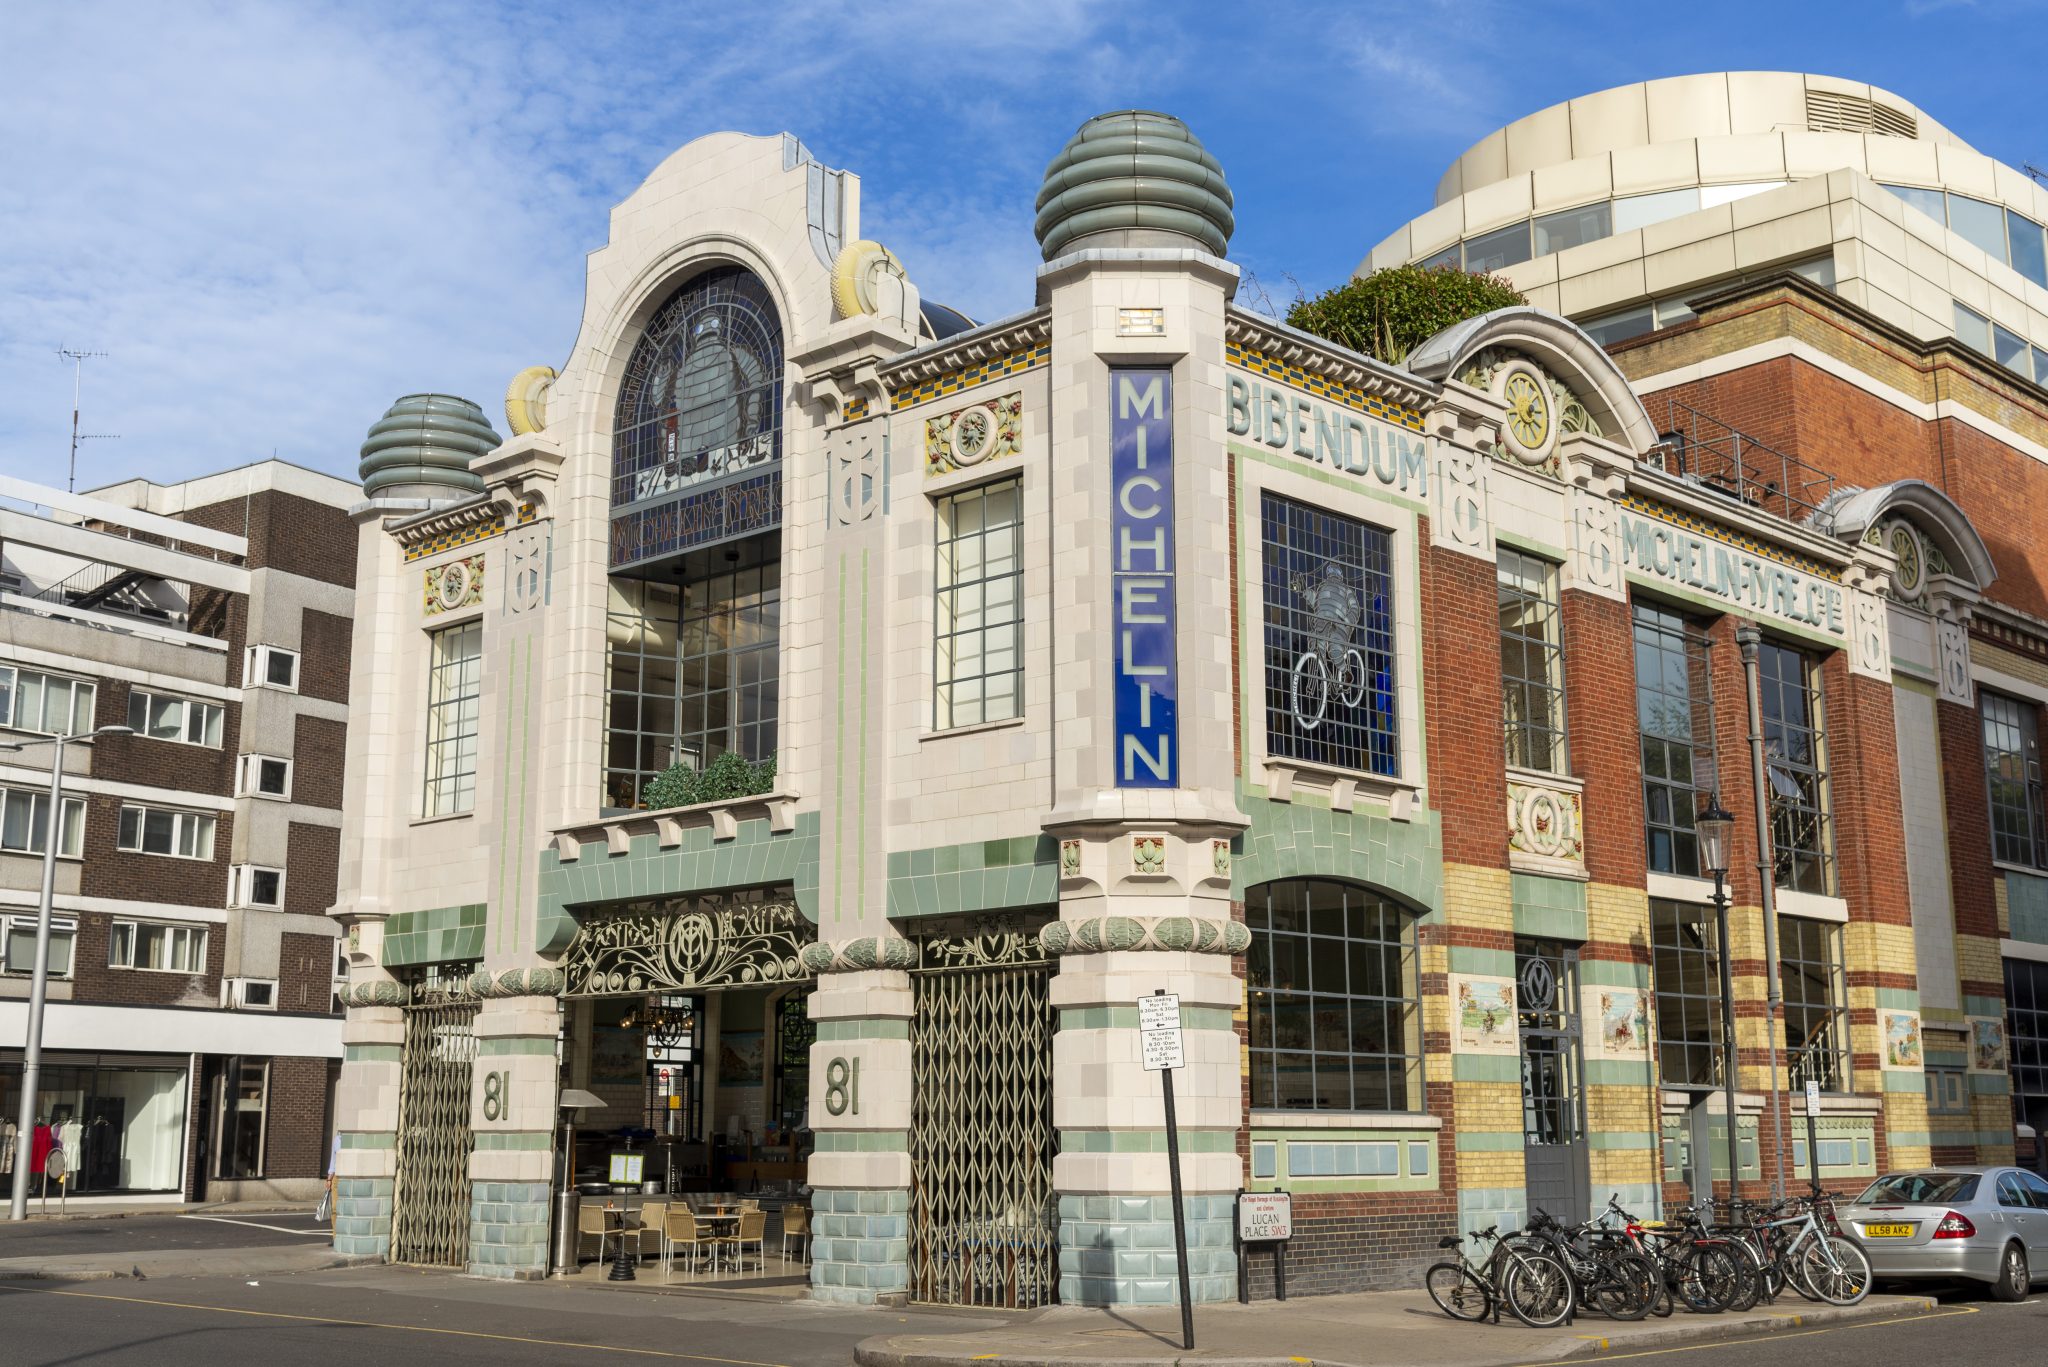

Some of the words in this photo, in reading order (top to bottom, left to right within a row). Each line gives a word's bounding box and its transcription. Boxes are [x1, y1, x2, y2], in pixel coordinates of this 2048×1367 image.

[1226, 372, 1427, 498] BIBENDUM
[1119, 374, 1170, 781] MICHELIN
[483, 1071, 510, 1121] 81
[826, 1056, 860, 1117] 81
[1252, 1214, 1280, 1225] LUCAN
[1868, 1225, 1891, 1235] LL58
[1892, 1225, 1910, 1235] AKZ
